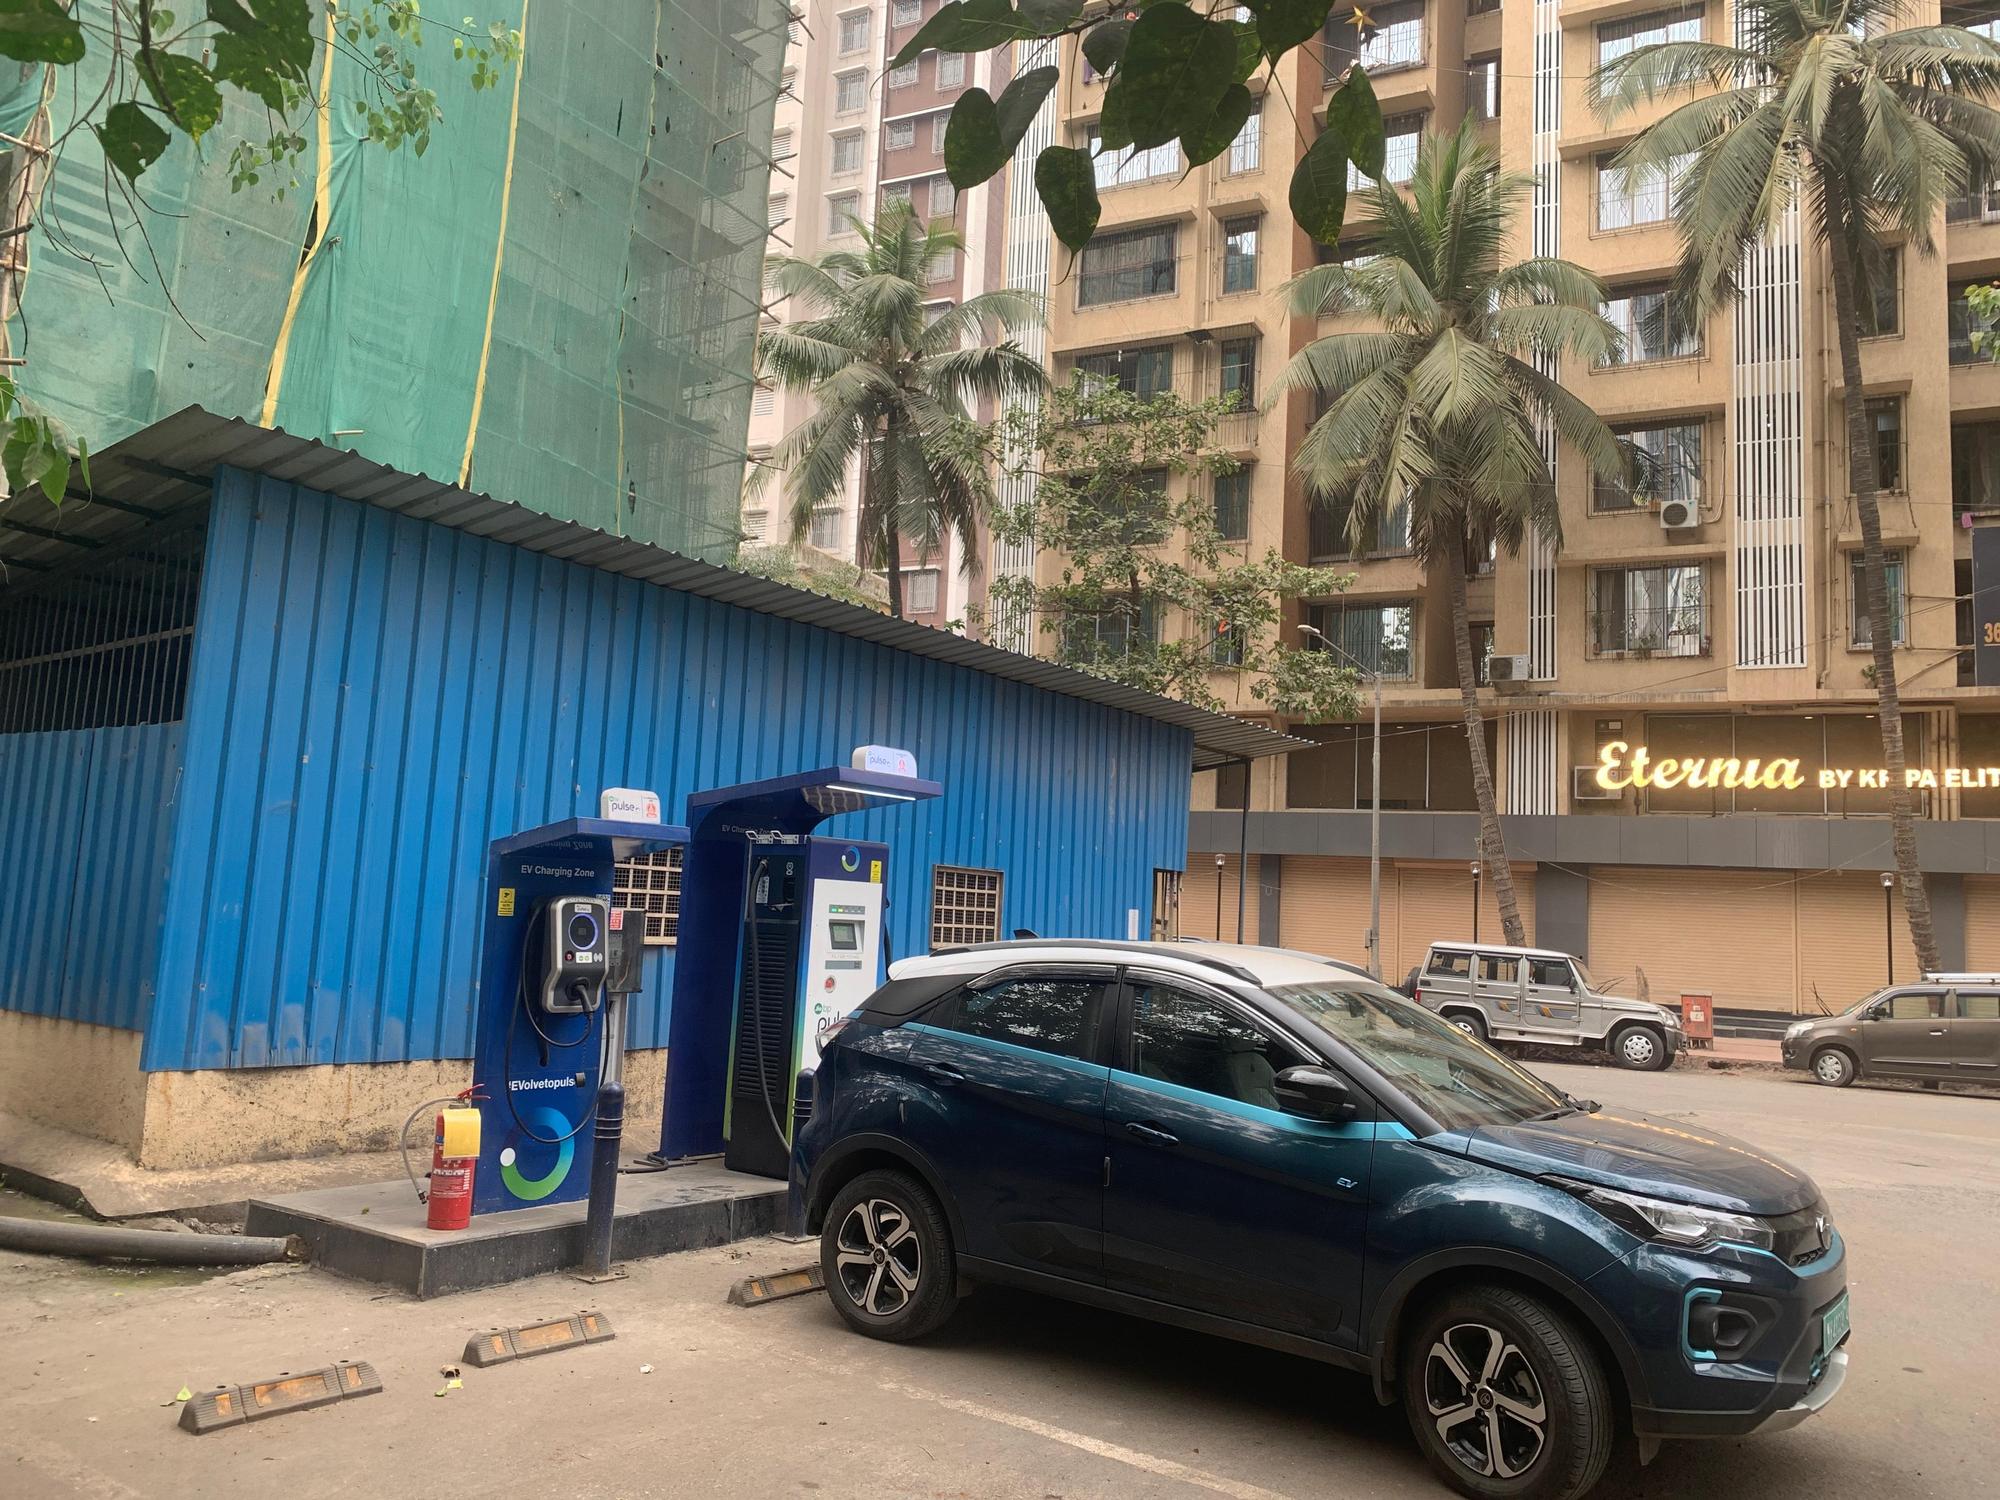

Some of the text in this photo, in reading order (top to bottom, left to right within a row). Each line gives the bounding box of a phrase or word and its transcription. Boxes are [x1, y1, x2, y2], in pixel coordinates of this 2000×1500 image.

[1595, 741, 1805, 789] Eternia
[1819, 768, 1853, 788] BY
[1859, 768, 1937, 788] KPA
[611, 801, 635, 812] pulse
[521, 864, 595, 877] EV Charging Zone
[509, 1077, 576, 1091] EVolvetopuls
[1336, 1177, 1358, 1188] EV
